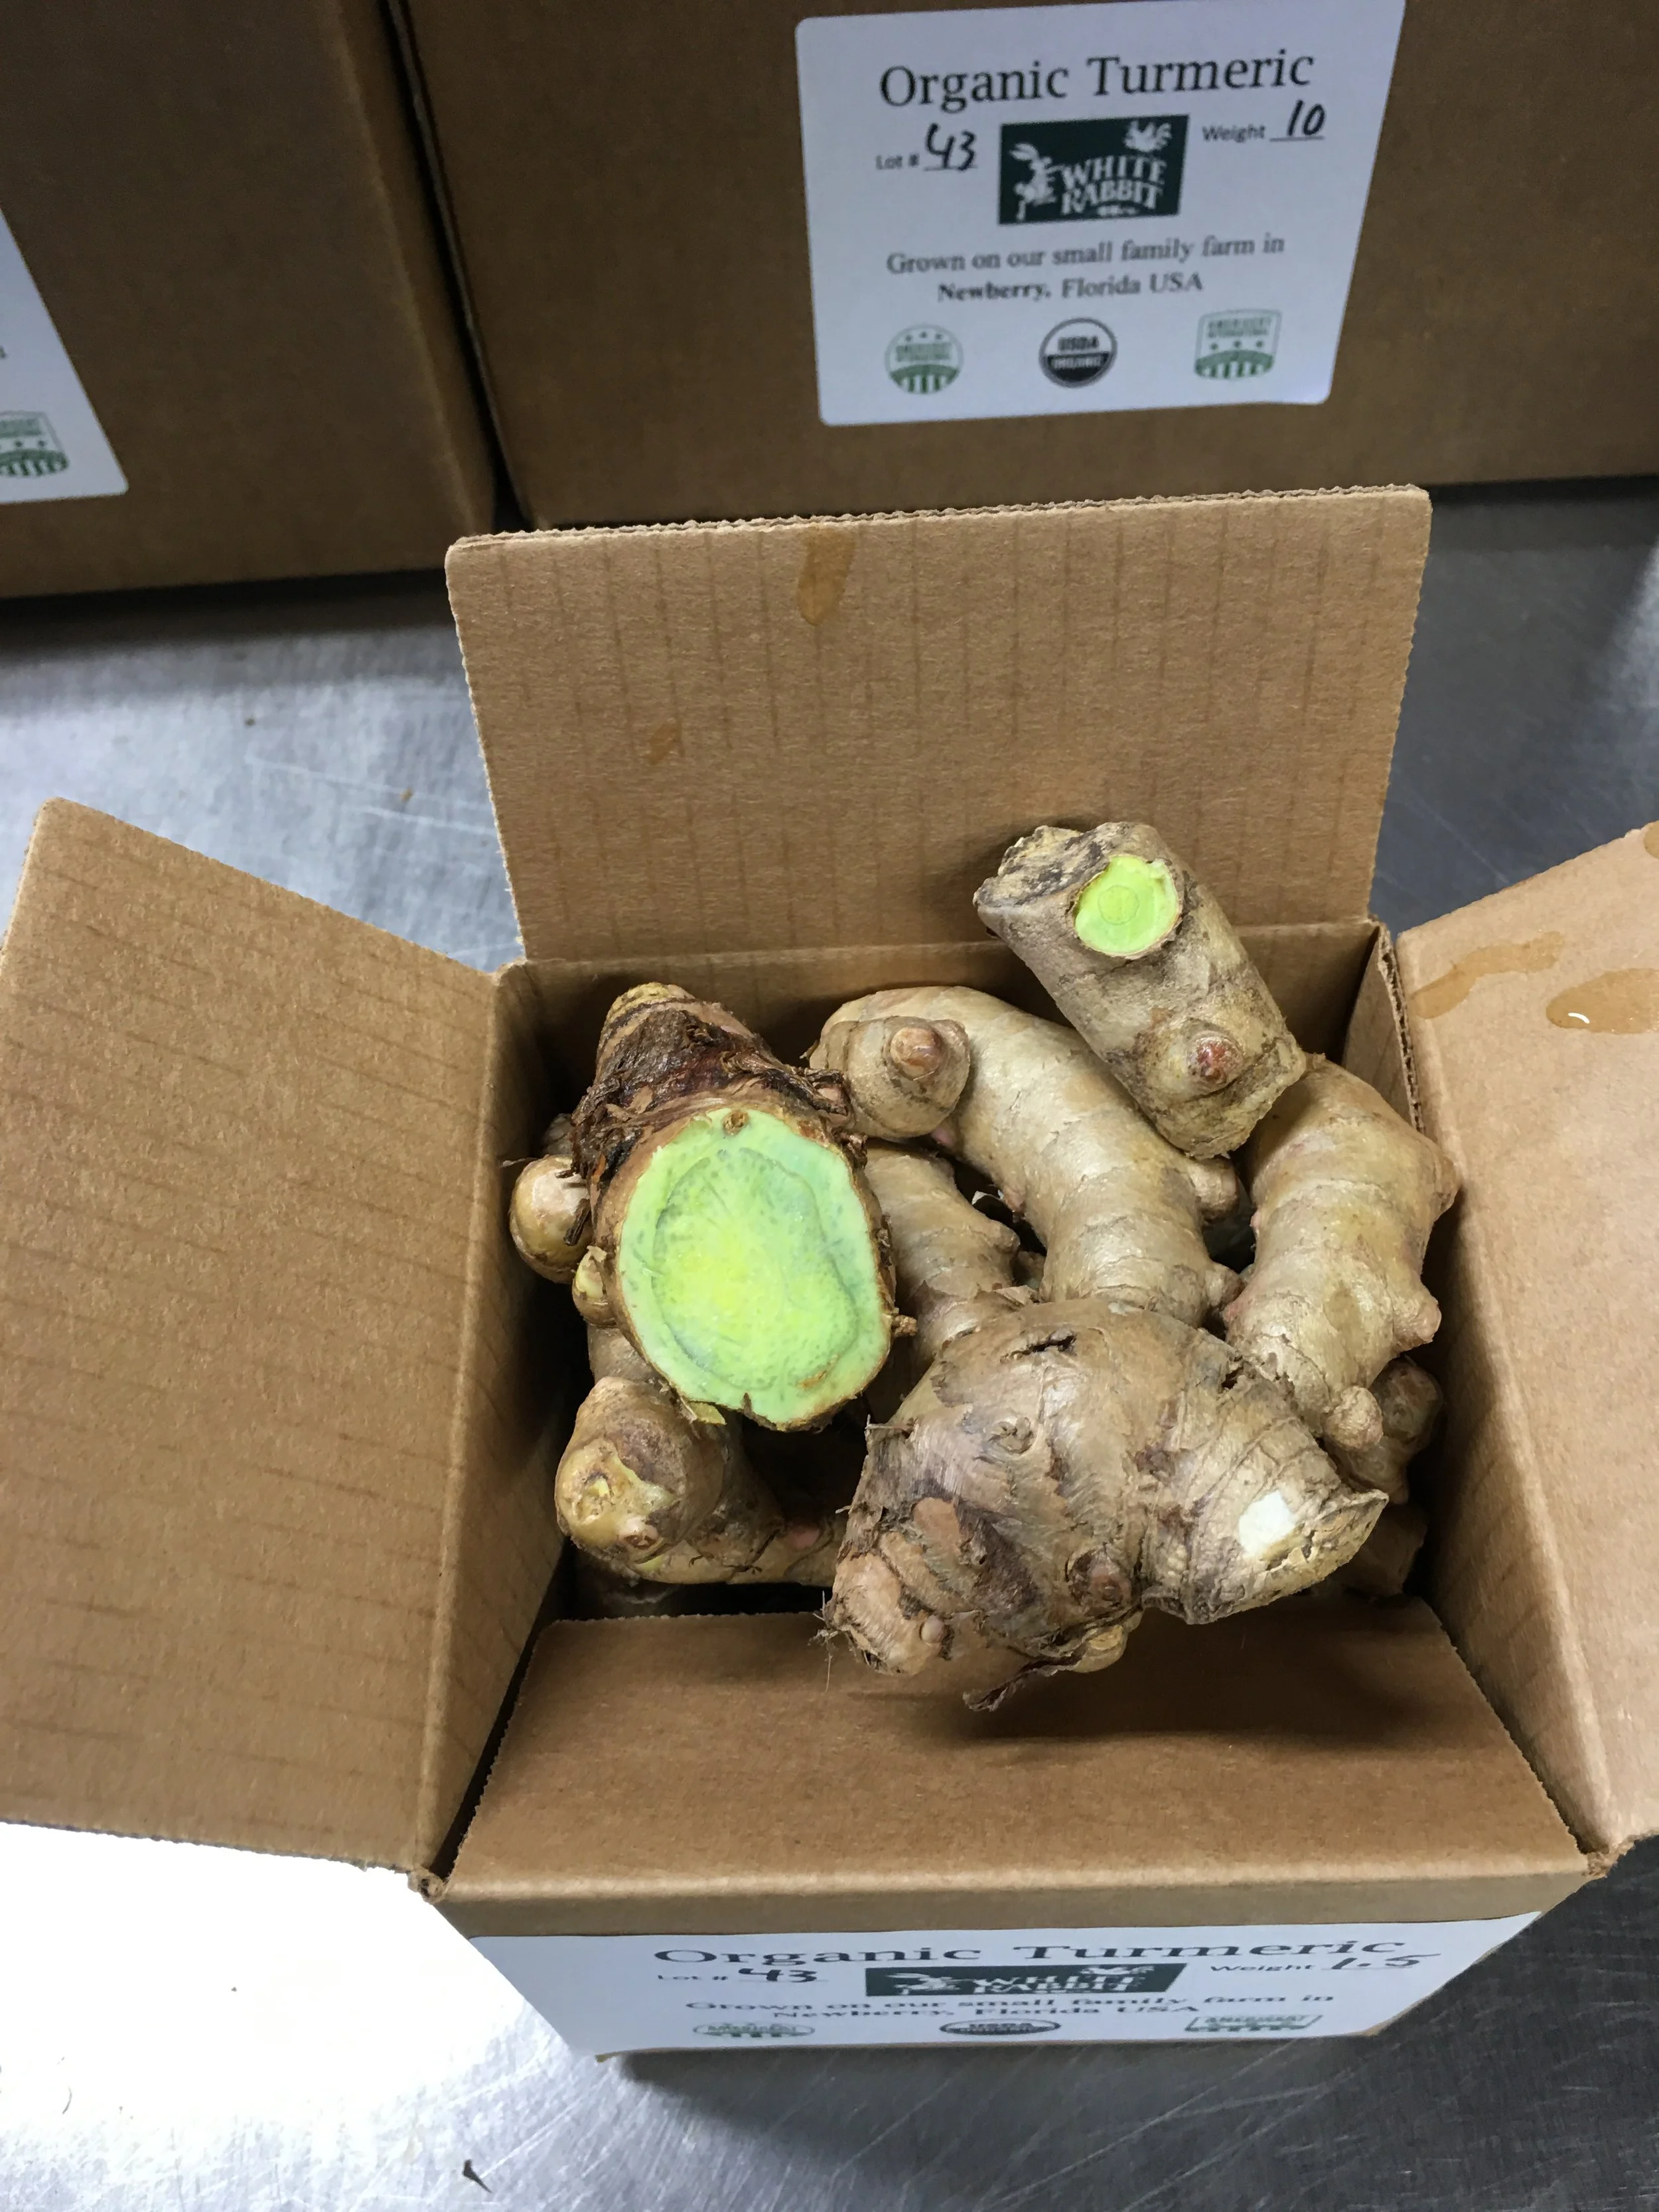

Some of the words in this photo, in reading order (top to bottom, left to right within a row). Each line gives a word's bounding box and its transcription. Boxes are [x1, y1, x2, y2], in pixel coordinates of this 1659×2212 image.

[880, 60, 1069, 114] Organic
[1086, 48, 1315, 96] Turmeric
[1202, 123, 1265, 143] Weight
[1287, 100, 1326, 137] 10
[876, 155, 903, 170] Lot
[925, 123, 977, 172] 43
[1062, 155, 1167, 190] WHITE
[1061, 180, 1163, 215] RABBIT
[887, 252, 966, 274] Grown
[972, 254, 1001, 269] on
[1006, 250, 1046, 267] our
[1052, 240, 1113, 265] small
[1121, 238, 1194, 263] family
[1202, 234, 1256, 257] farm
[1263, 232, 1285, 254] in
[937, 281, 1052, 302] Newberry,
[1061, 273, 1141, 299] Florida
[1149, 271, 1204, 293] USA
[654, 1947, 981, 1966] Organic
[1013, 1941, 1406, 1958] Turmeric
[738, 1968, 818, 1983] 43
[685, 2002, 812, 2010] Grown
